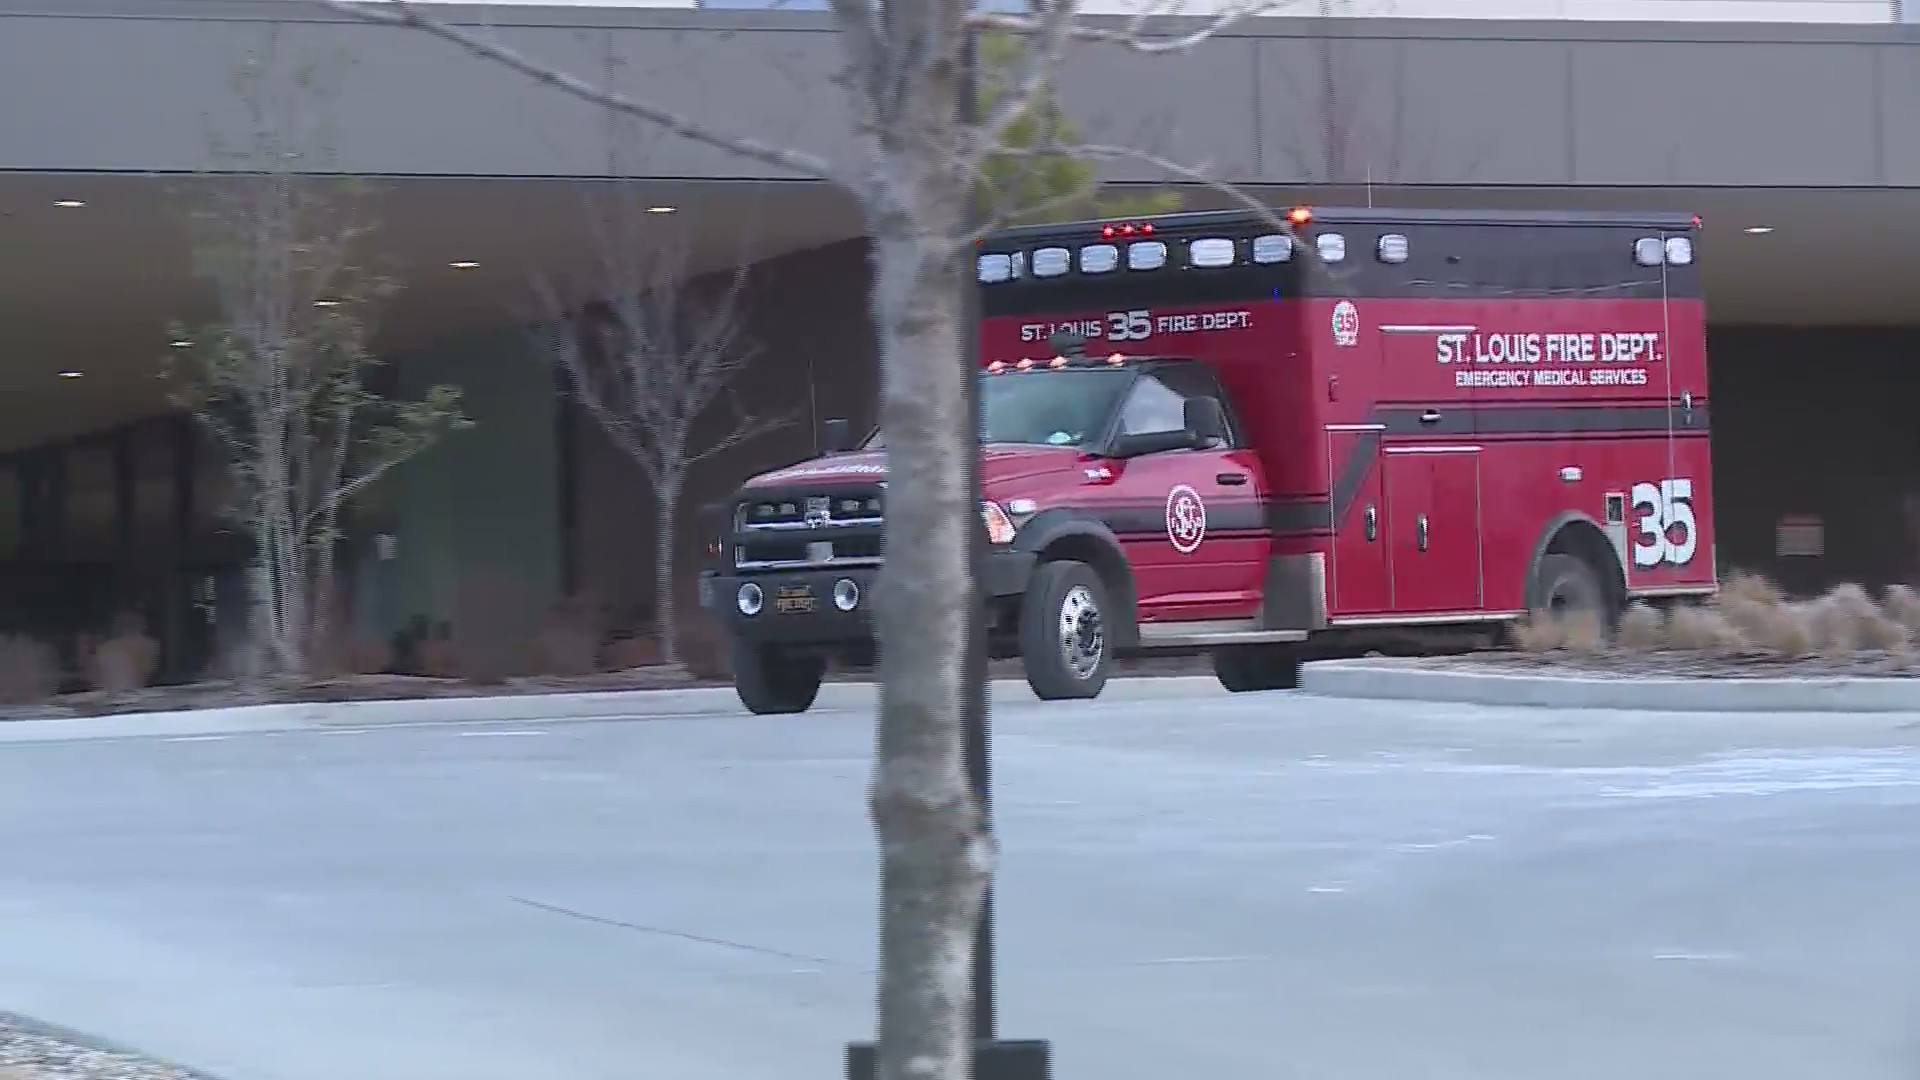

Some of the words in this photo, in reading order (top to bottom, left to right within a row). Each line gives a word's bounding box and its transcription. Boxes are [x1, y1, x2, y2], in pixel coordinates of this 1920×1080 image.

[1020, 323, 1047, 341] ST.
[1106, 309, 1152, 342] 35
[1156, 314, 1199, 334] FIRE
[1202, 311, 1253, 330] DEPT.
[1436, 333, 1471, 364] ST.
[1475, 332, 1541, 364] LOUIS
[1545, 332, 1595, 363] FIRE
[1600, 332, 1664, 362] DEPT.
[1455, 369, 1530, 388] EMERGENCY
[1533, 369, 1587, 387] MEDICAL
[1589, 368, 1648, 386] SERVICES
[1631, 479, 1697, 567] 35
